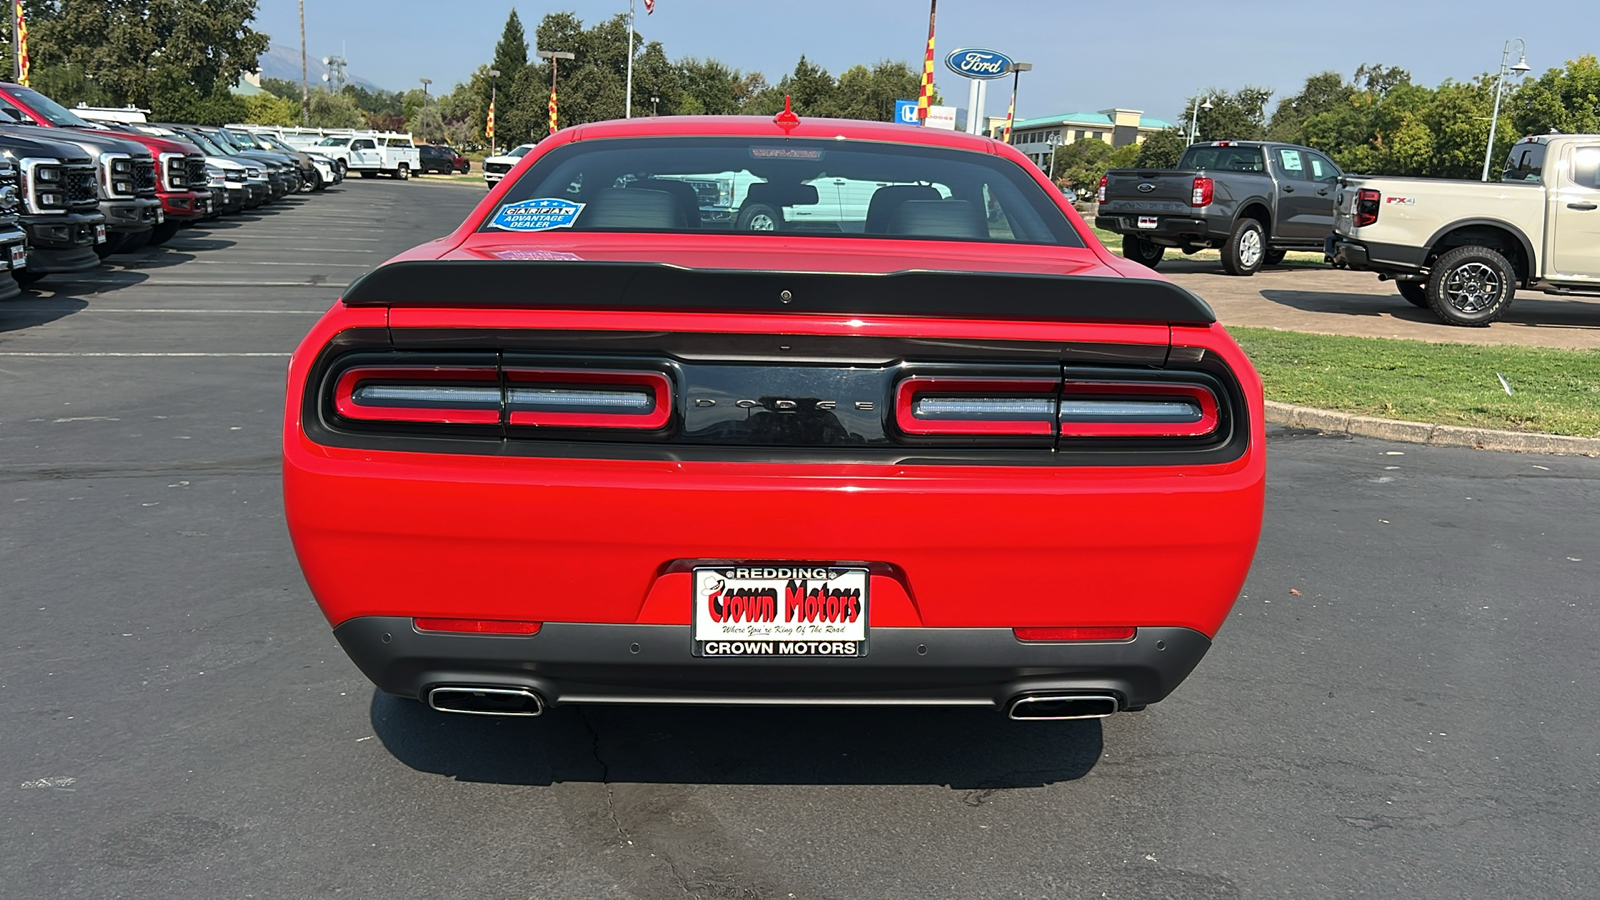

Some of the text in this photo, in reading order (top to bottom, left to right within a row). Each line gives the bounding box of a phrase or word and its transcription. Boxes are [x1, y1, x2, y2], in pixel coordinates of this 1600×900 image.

[961, 52, 1002, 73] Ford
[504, 207, 575, 215] CARFAX
[695, 398, 875, 411] DODGE
[736, 568, 828, 579] REDDING
[708, 580, 861, 623] Crown Motors
[722, 625, 846, 635] Where You're King Of The Road
[705, 642, 856, 654] CROWN MOTORS
